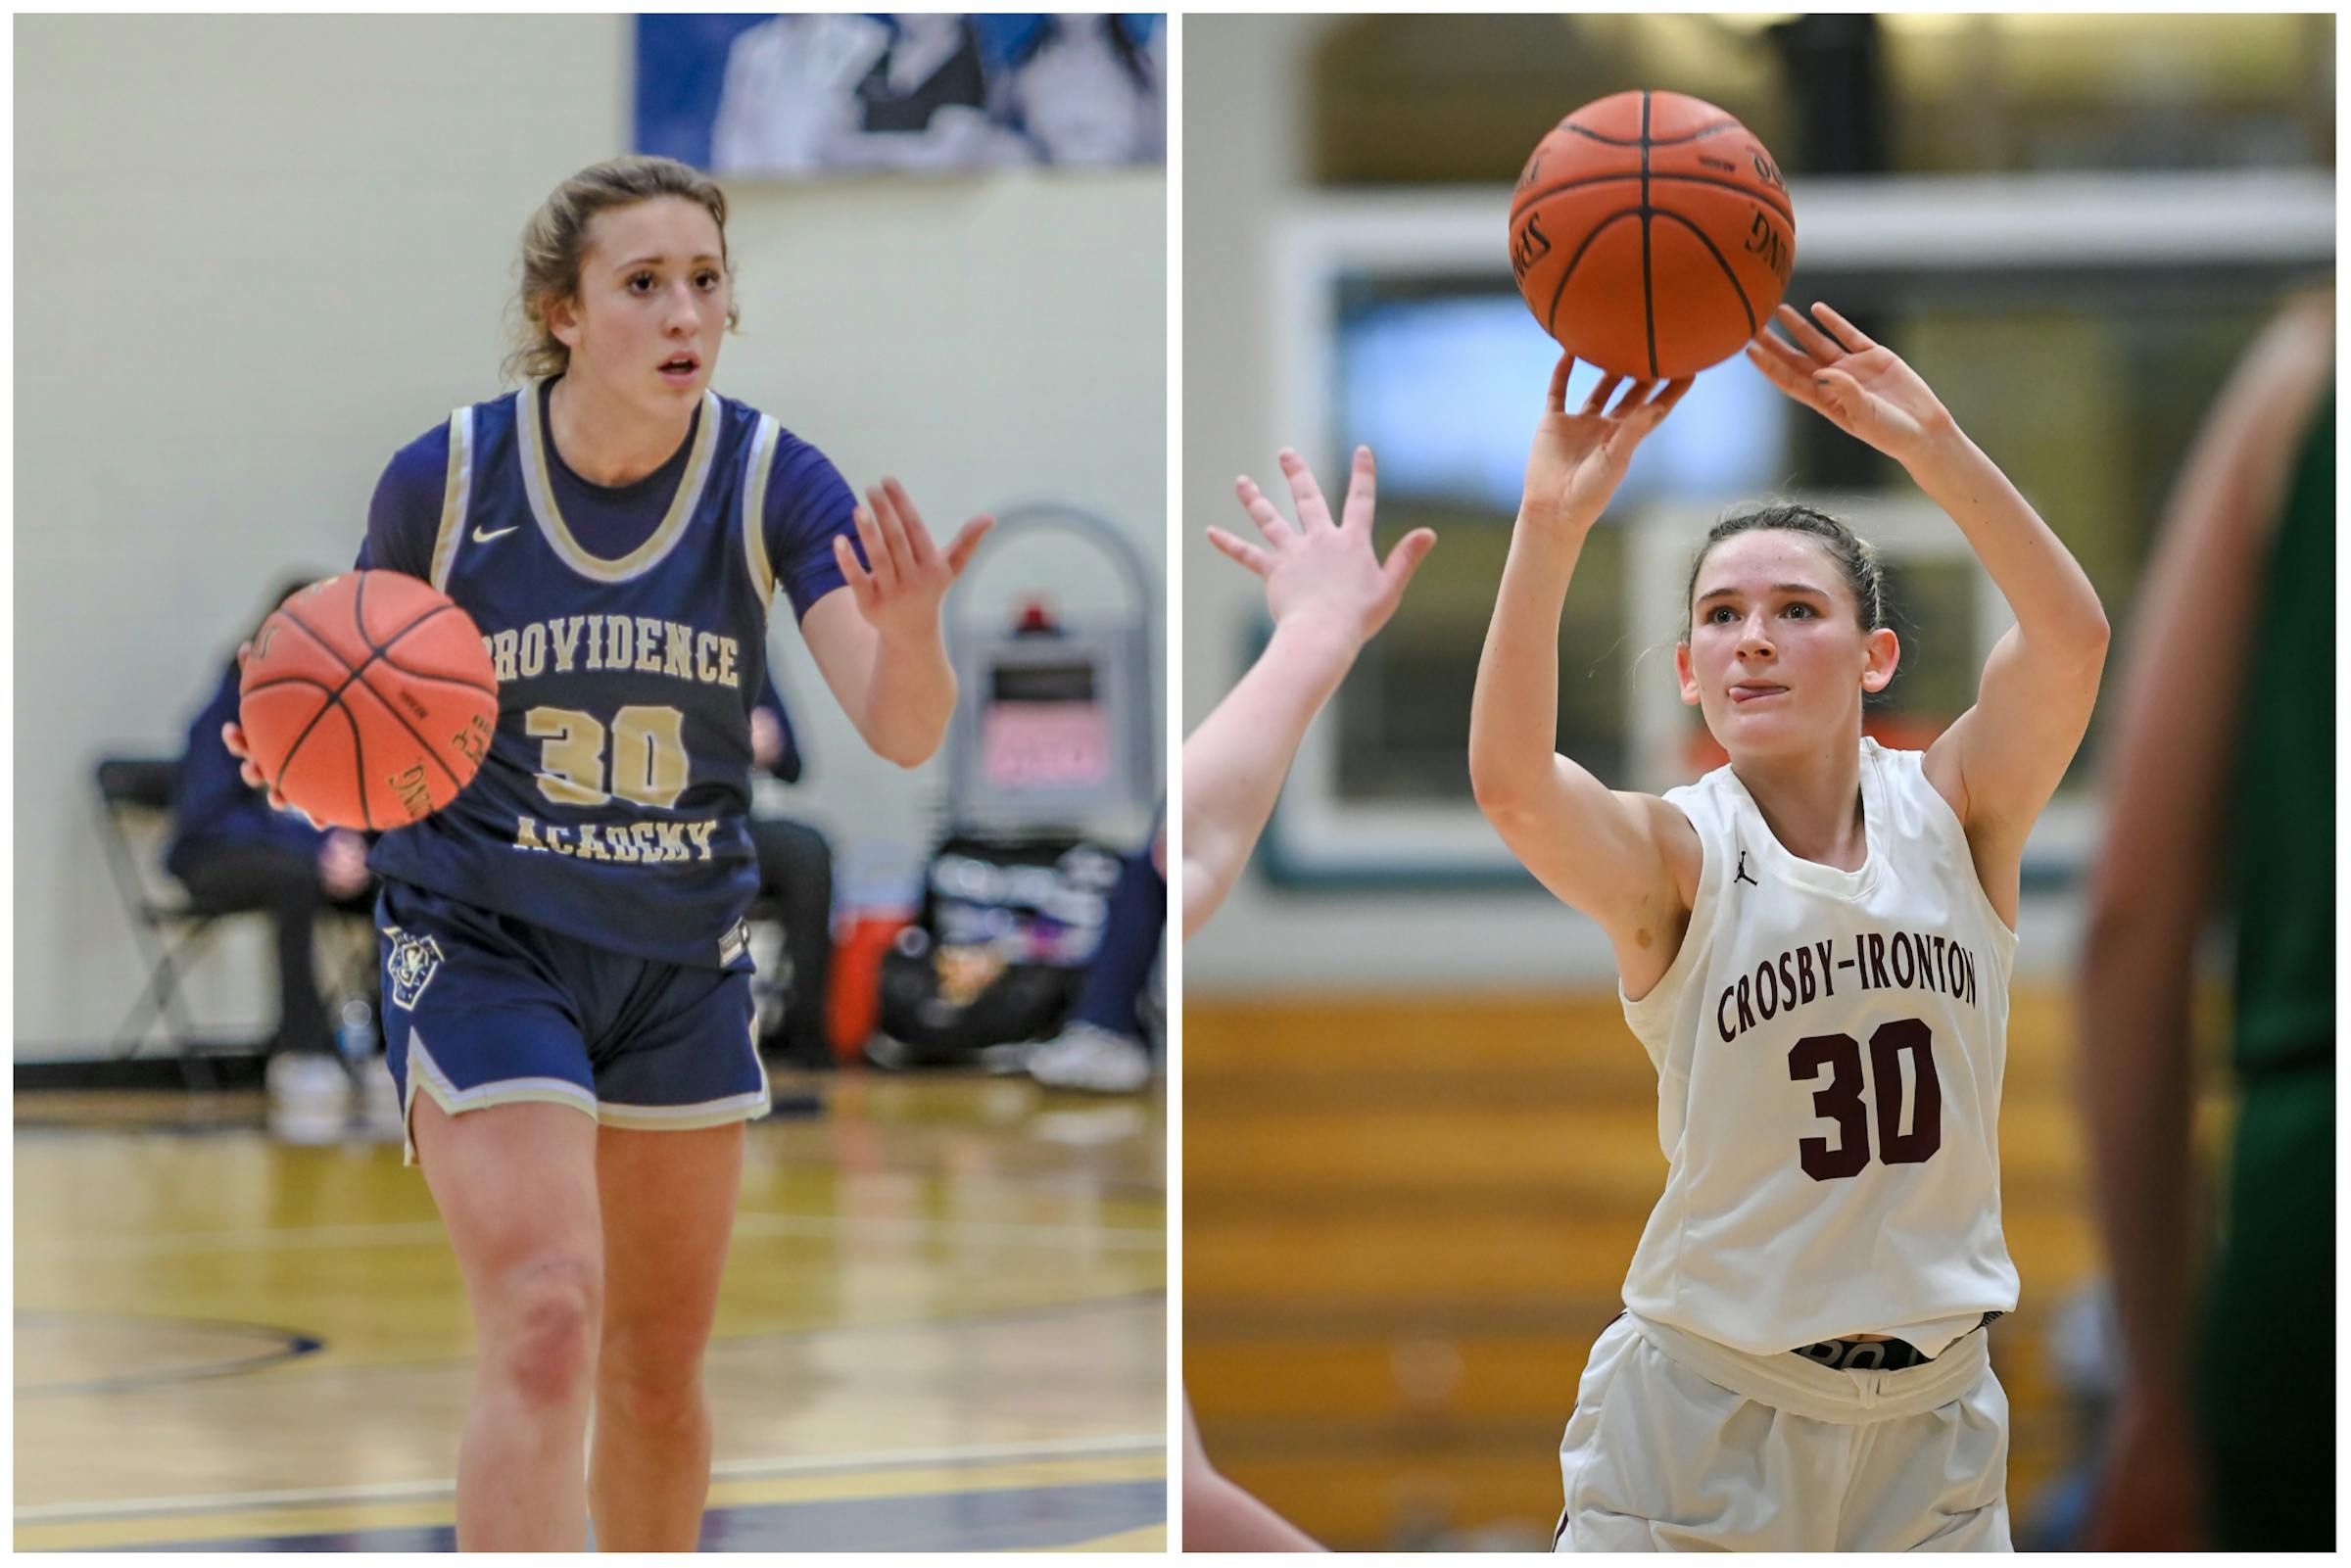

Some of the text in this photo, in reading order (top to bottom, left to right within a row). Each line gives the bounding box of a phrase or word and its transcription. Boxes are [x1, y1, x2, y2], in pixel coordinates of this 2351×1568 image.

[525, 705, 690, 809] 30
[512, 815, 717, 863] ACADEMY
[1716, 931, 1976, 1043] CROSBY-IRONTON
[1788, 1018, 1942, 1181] 30
